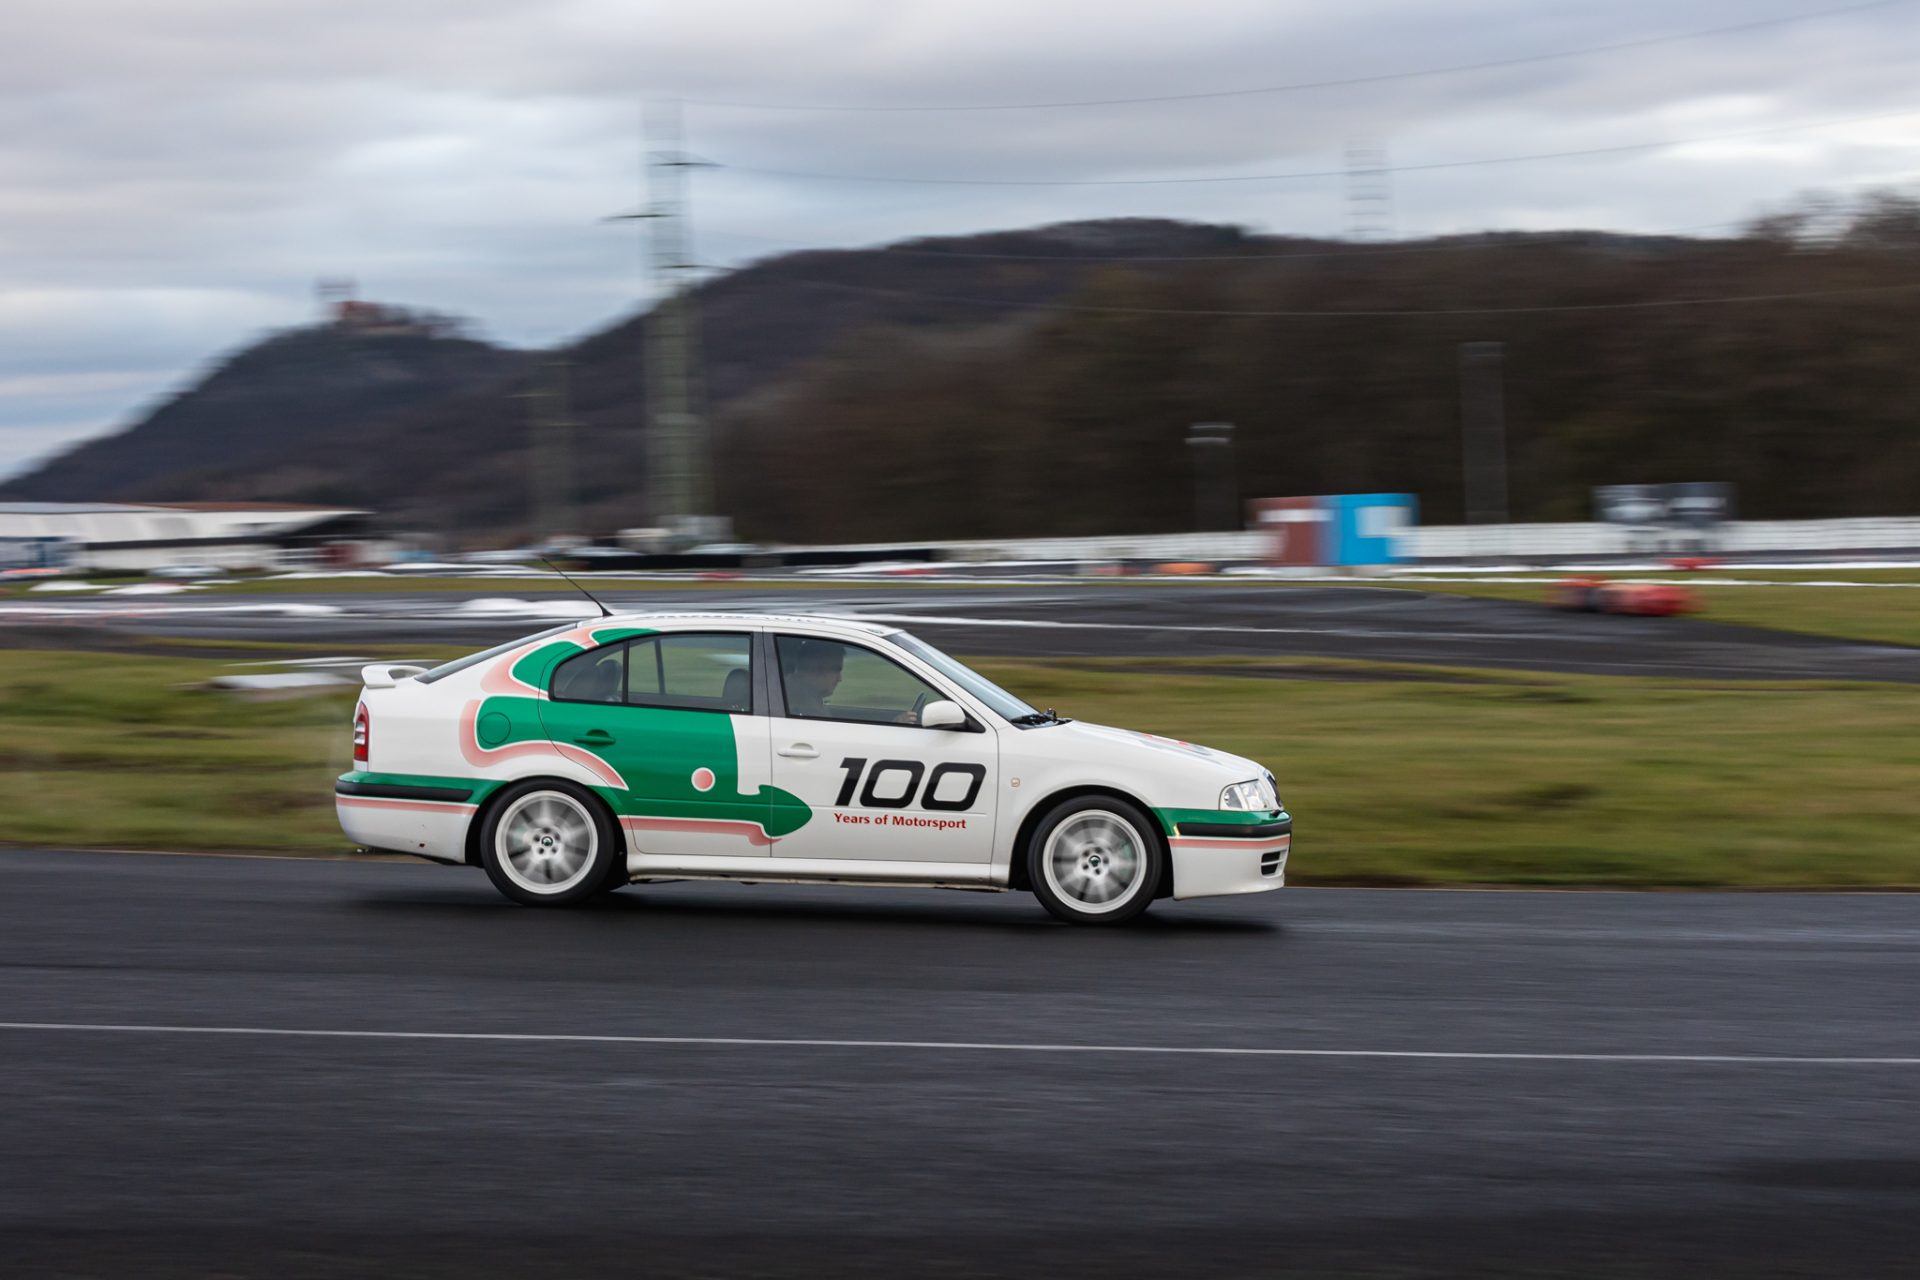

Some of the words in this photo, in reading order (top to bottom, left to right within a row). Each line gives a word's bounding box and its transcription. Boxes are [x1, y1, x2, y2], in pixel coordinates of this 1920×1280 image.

[835, 757, 987, 811] 100
[834, 813, 870, 824] Years
[874, 814, 888, 825] of
[892, 816, 967, 830] Motorsport
